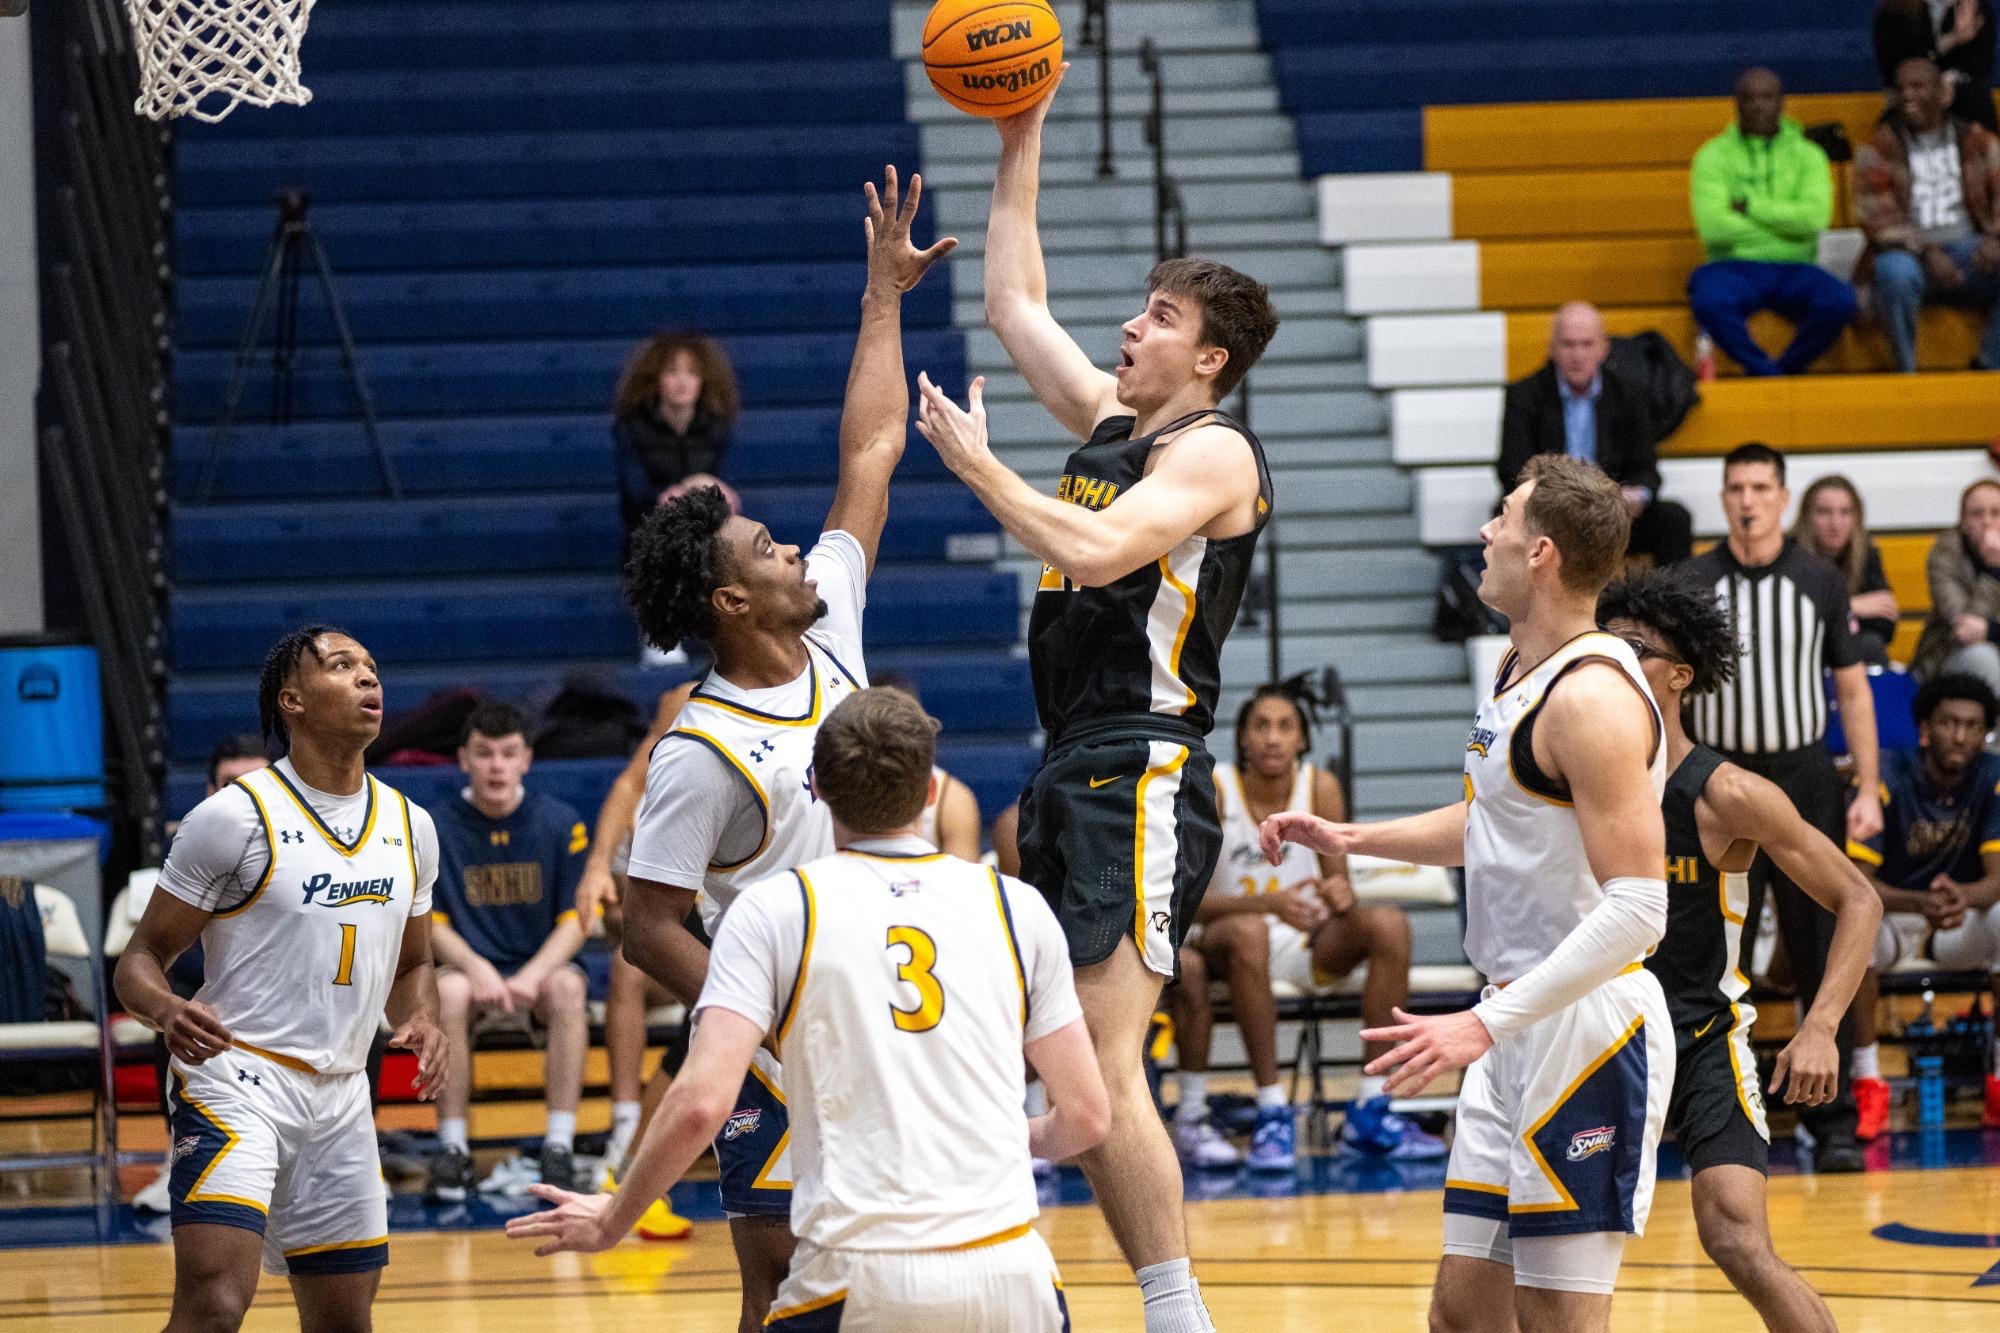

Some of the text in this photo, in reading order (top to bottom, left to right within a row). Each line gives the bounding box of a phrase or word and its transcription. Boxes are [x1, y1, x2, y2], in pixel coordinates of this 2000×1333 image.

[965, 19, 1032, 52] NCAA
[961, 57, 1052, 92] Wilson
[302, 873, 394, 905] PENMEN
[332, 923, 357, 986] 1
[886, 925, 945, 1033] 3
[1567, 1130, 1614, 1158] SNHU
